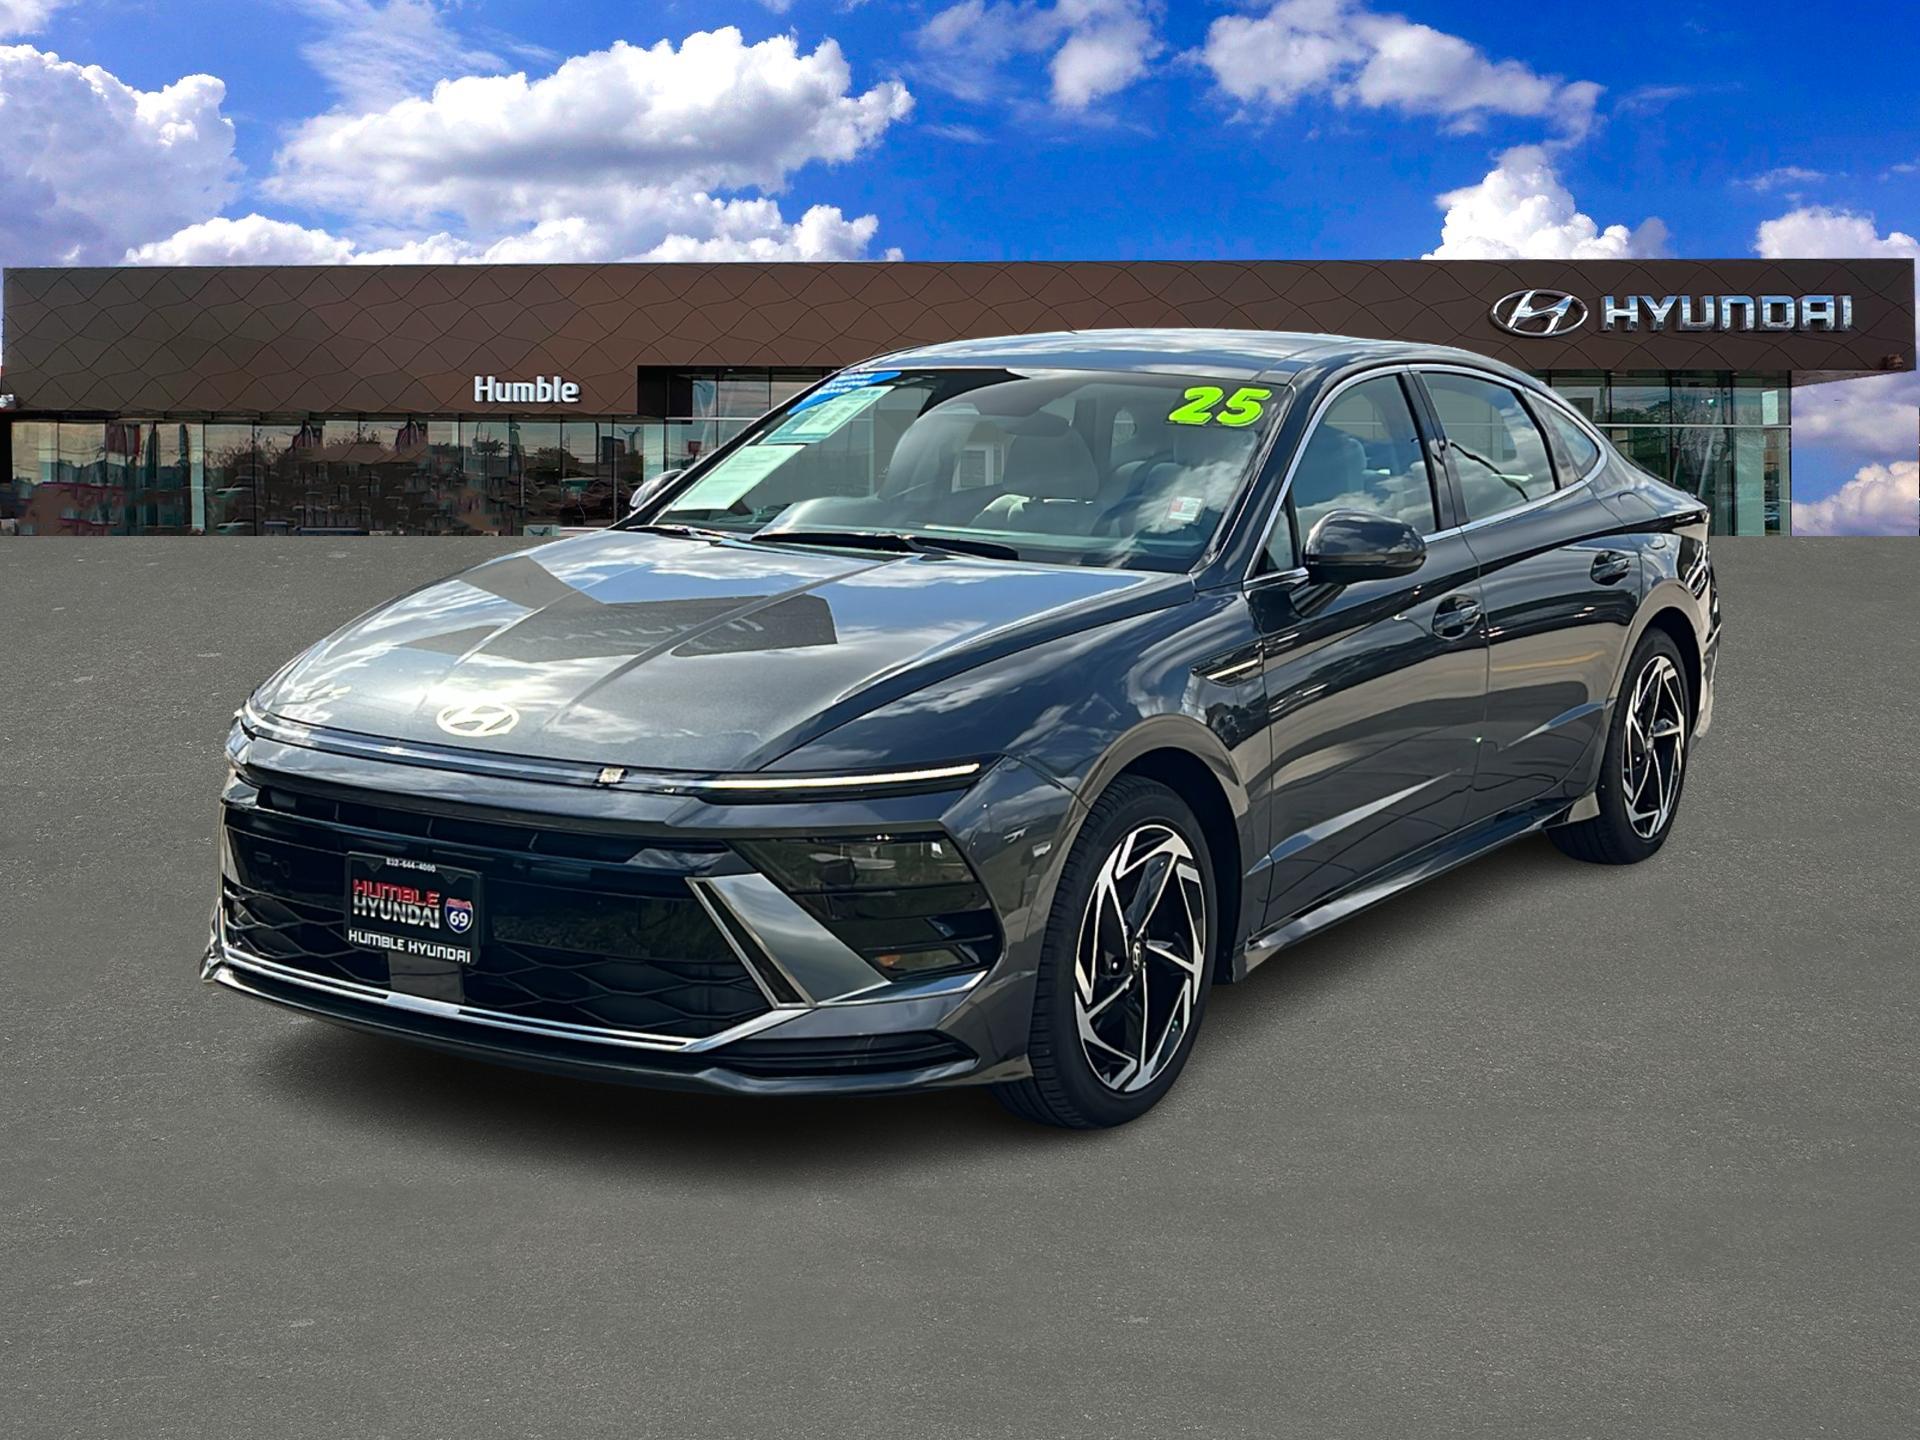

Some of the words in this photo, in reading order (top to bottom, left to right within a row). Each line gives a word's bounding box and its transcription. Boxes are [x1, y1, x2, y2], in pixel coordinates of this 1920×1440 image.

[1603, 295, 1853, 331] HYUNDAI
[474, 376, 579, 402] Humble
[1168, 387, 1272, 427] 25
[353, 879, 440, 908] HUMBLE
[353, 895, 440, 929] HYUNDAI
[450, 911, 469, 927] 69
[349, 930, 405, 951] HUMBLE
[408, 940, 471, 963] HYUNDAI
